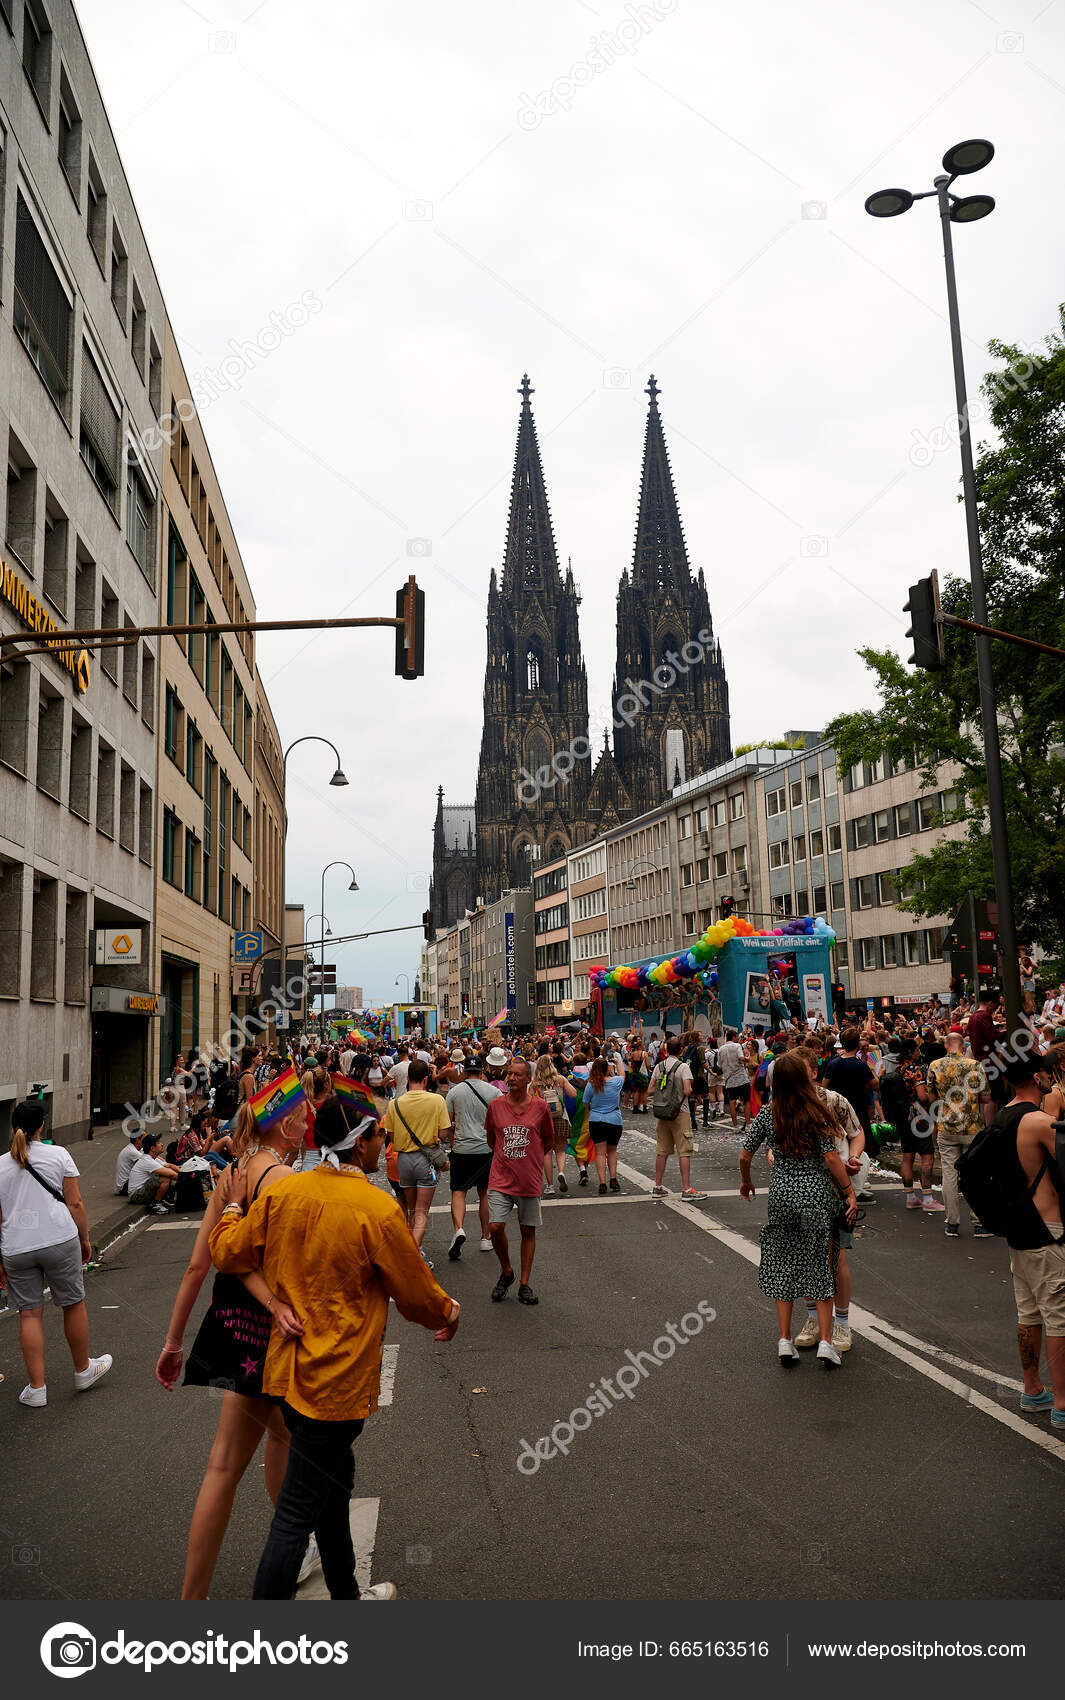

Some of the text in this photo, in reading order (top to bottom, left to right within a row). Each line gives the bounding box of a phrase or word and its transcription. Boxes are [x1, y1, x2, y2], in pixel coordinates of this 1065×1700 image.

[244, 940, 258, 955] P
[742, 937, 823, 947] Weil uns Vielfalt eint.
[506, 926, 516, 995] aohostels.com
[503, 1126, 531, 1135] STREET
